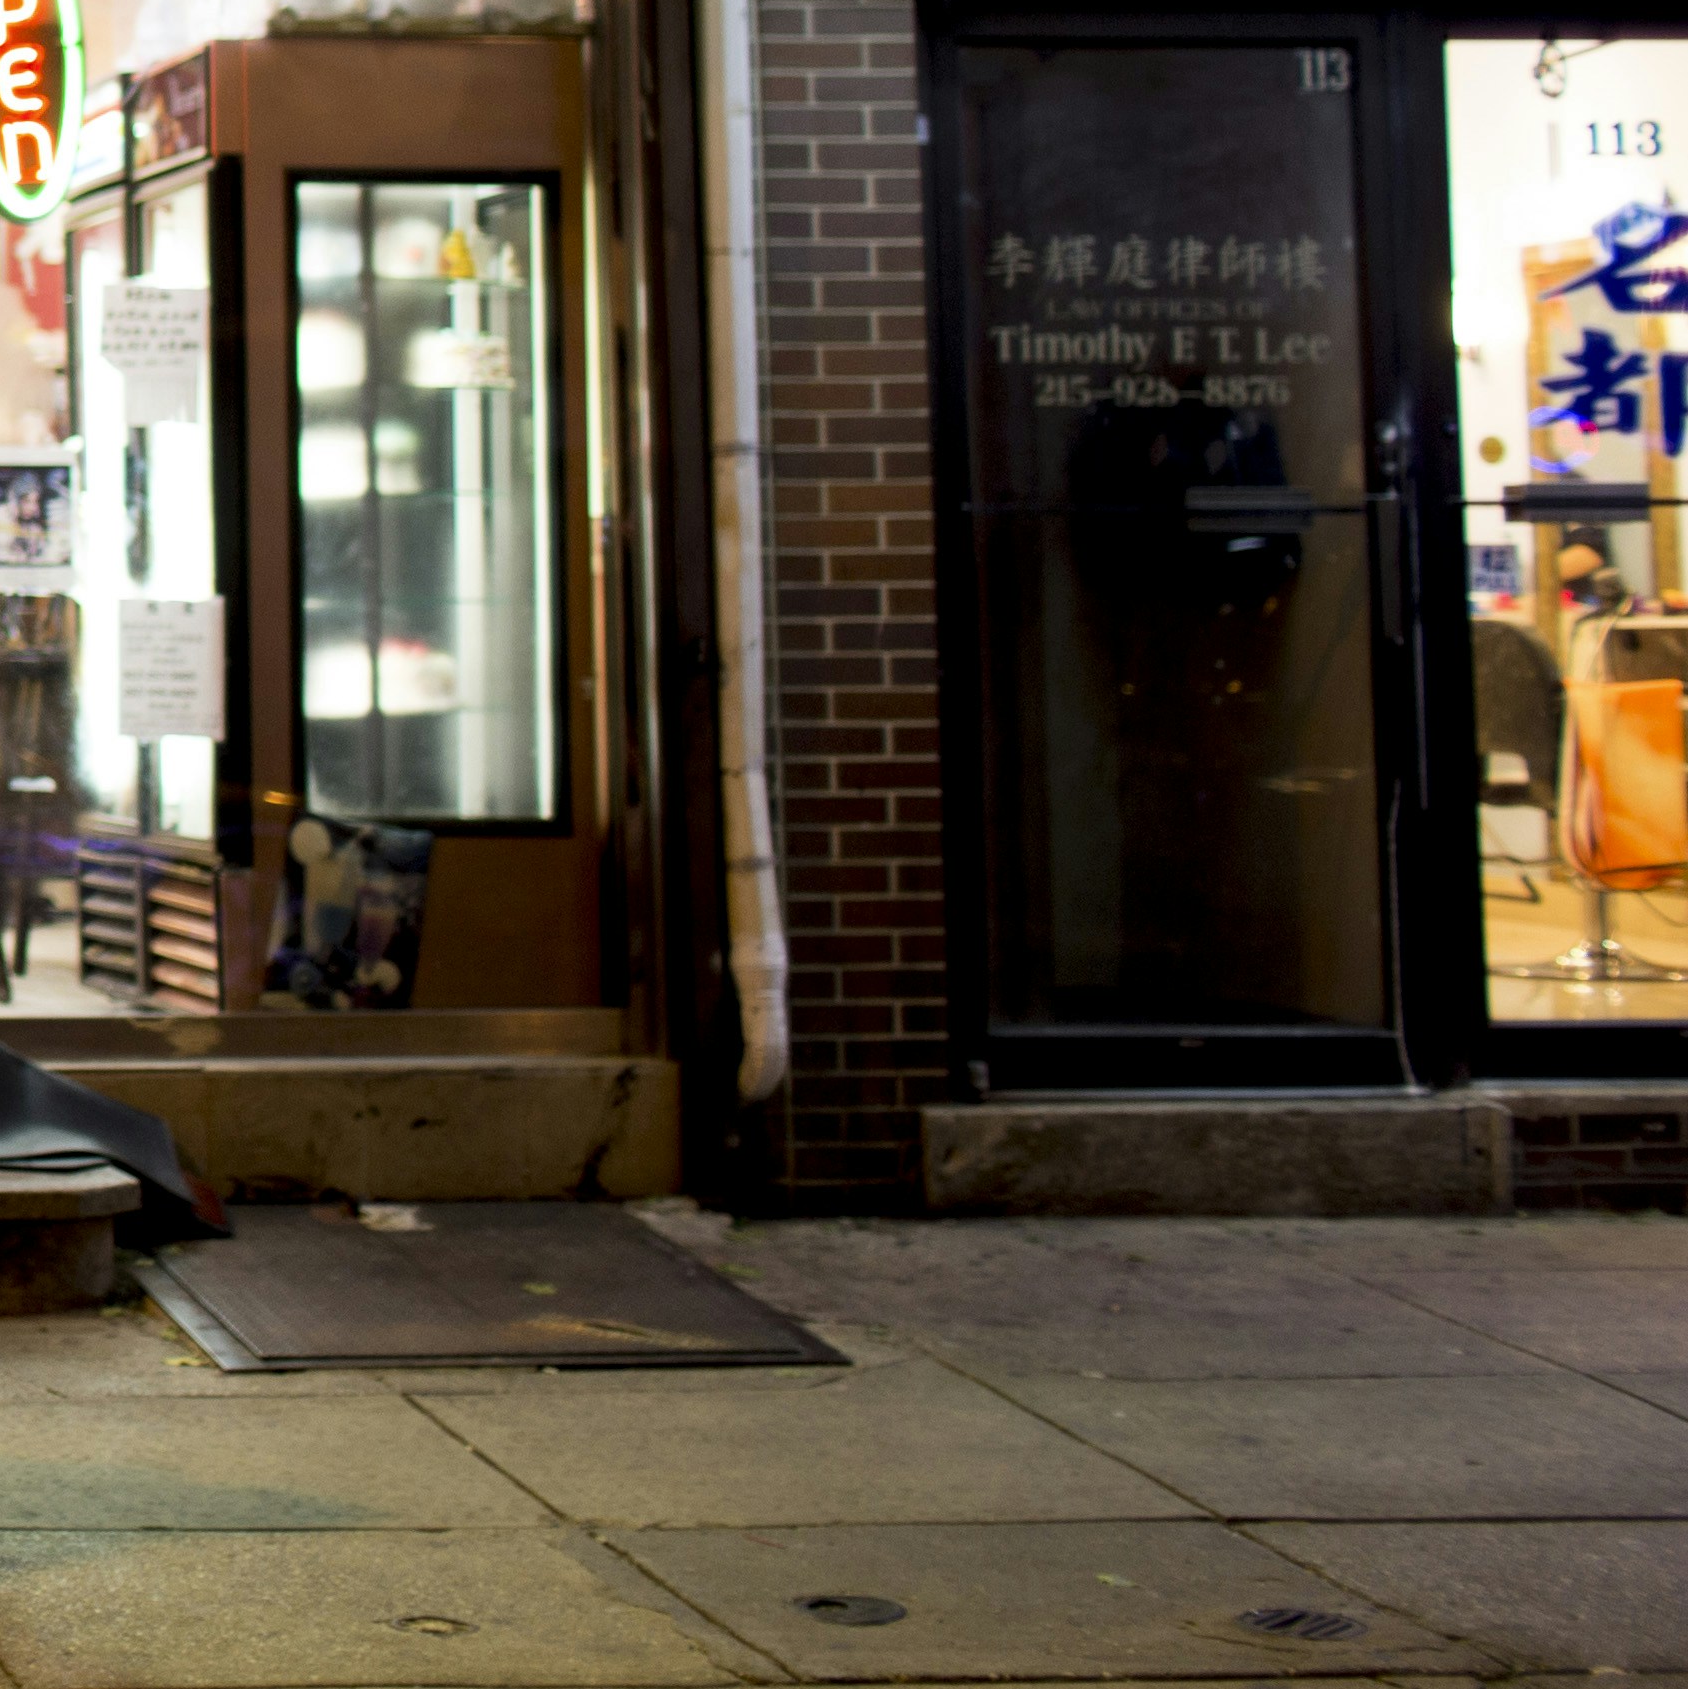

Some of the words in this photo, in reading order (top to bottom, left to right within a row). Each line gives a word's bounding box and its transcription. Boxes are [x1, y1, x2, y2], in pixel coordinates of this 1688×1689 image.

[1299, 49, 1350, 91] 113
[1587, 120, 1662, 156] 113
[990, 323, 1154, 371] Timothy
[1256, 326, 1332, 362] Lee
